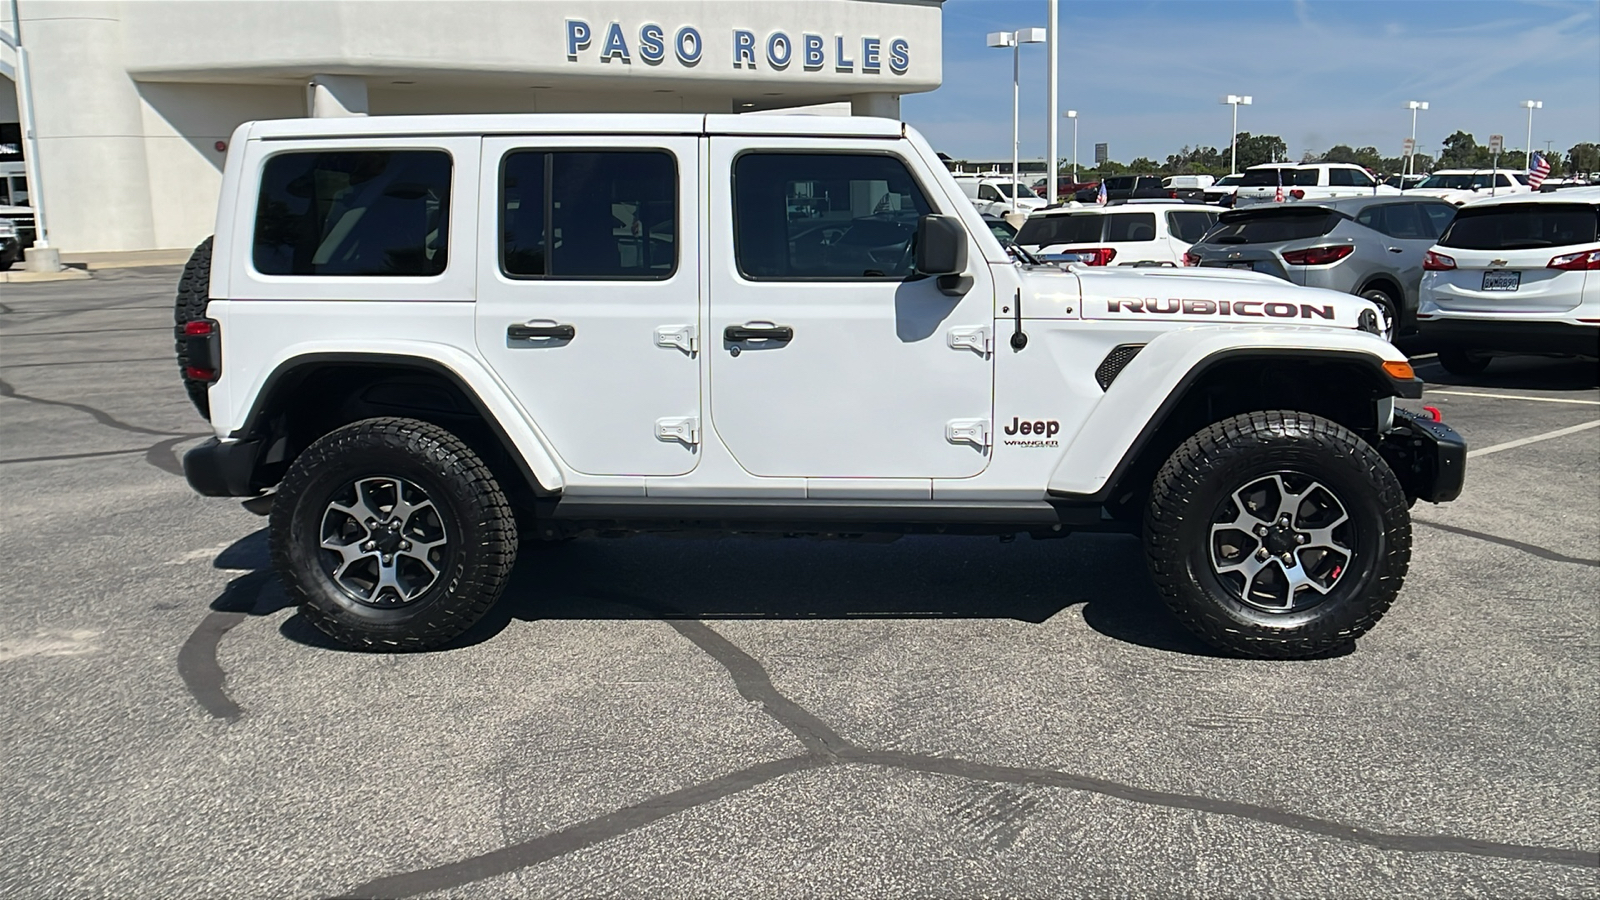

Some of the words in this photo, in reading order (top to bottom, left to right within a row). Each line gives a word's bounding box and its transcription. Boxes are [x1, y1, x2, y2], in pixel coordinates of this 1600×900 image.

[565, 18, 703, 65] PASO
[732, 28, 909, 73] ROBLES
[1107, 296, 1335, 320] RUBICON
[1004, 417, 1060, 438] Jeep
